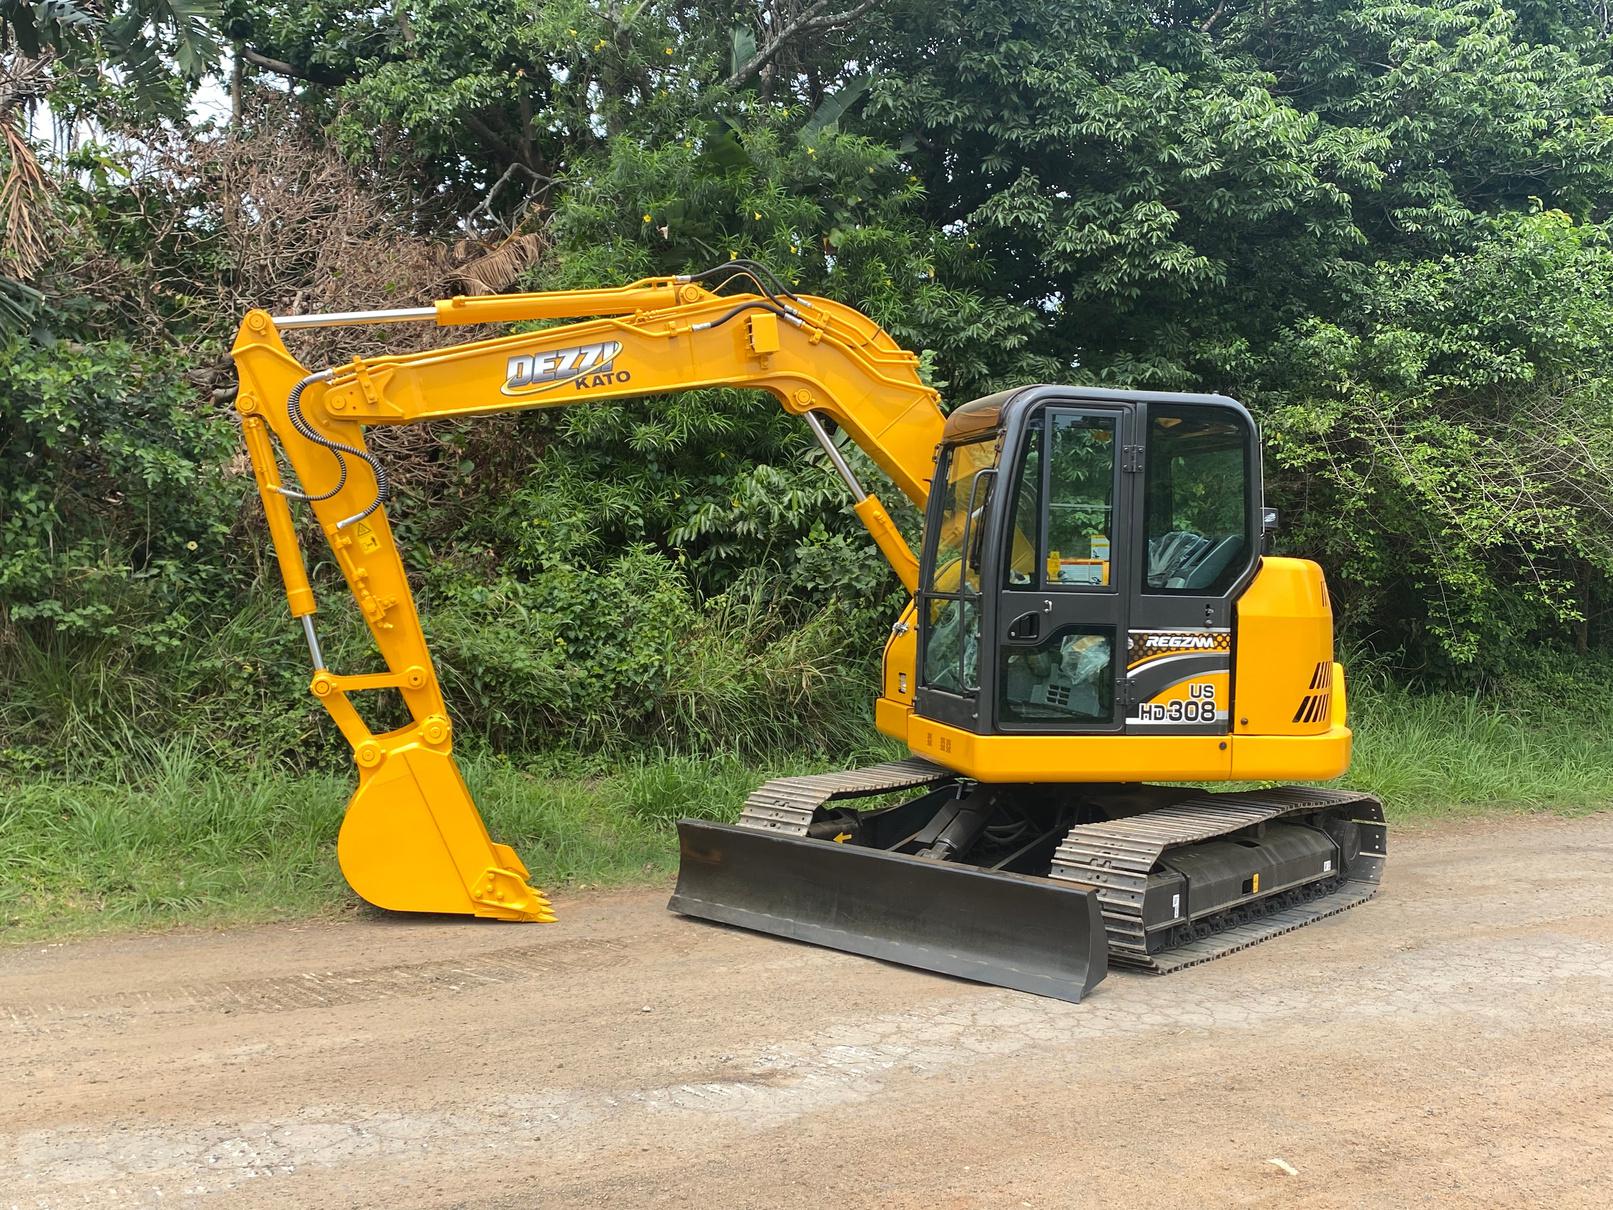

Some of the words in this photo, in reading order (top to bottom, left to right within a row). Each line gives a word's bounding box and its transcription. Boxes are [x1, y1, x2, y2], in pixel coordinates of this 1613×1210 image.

[506, 341, 615, 388] DEZZI
[575, 370, 631, 390] KATO
[1190, 684, 1214, 699] US
[1140, 700, 1216, 722] HD308
